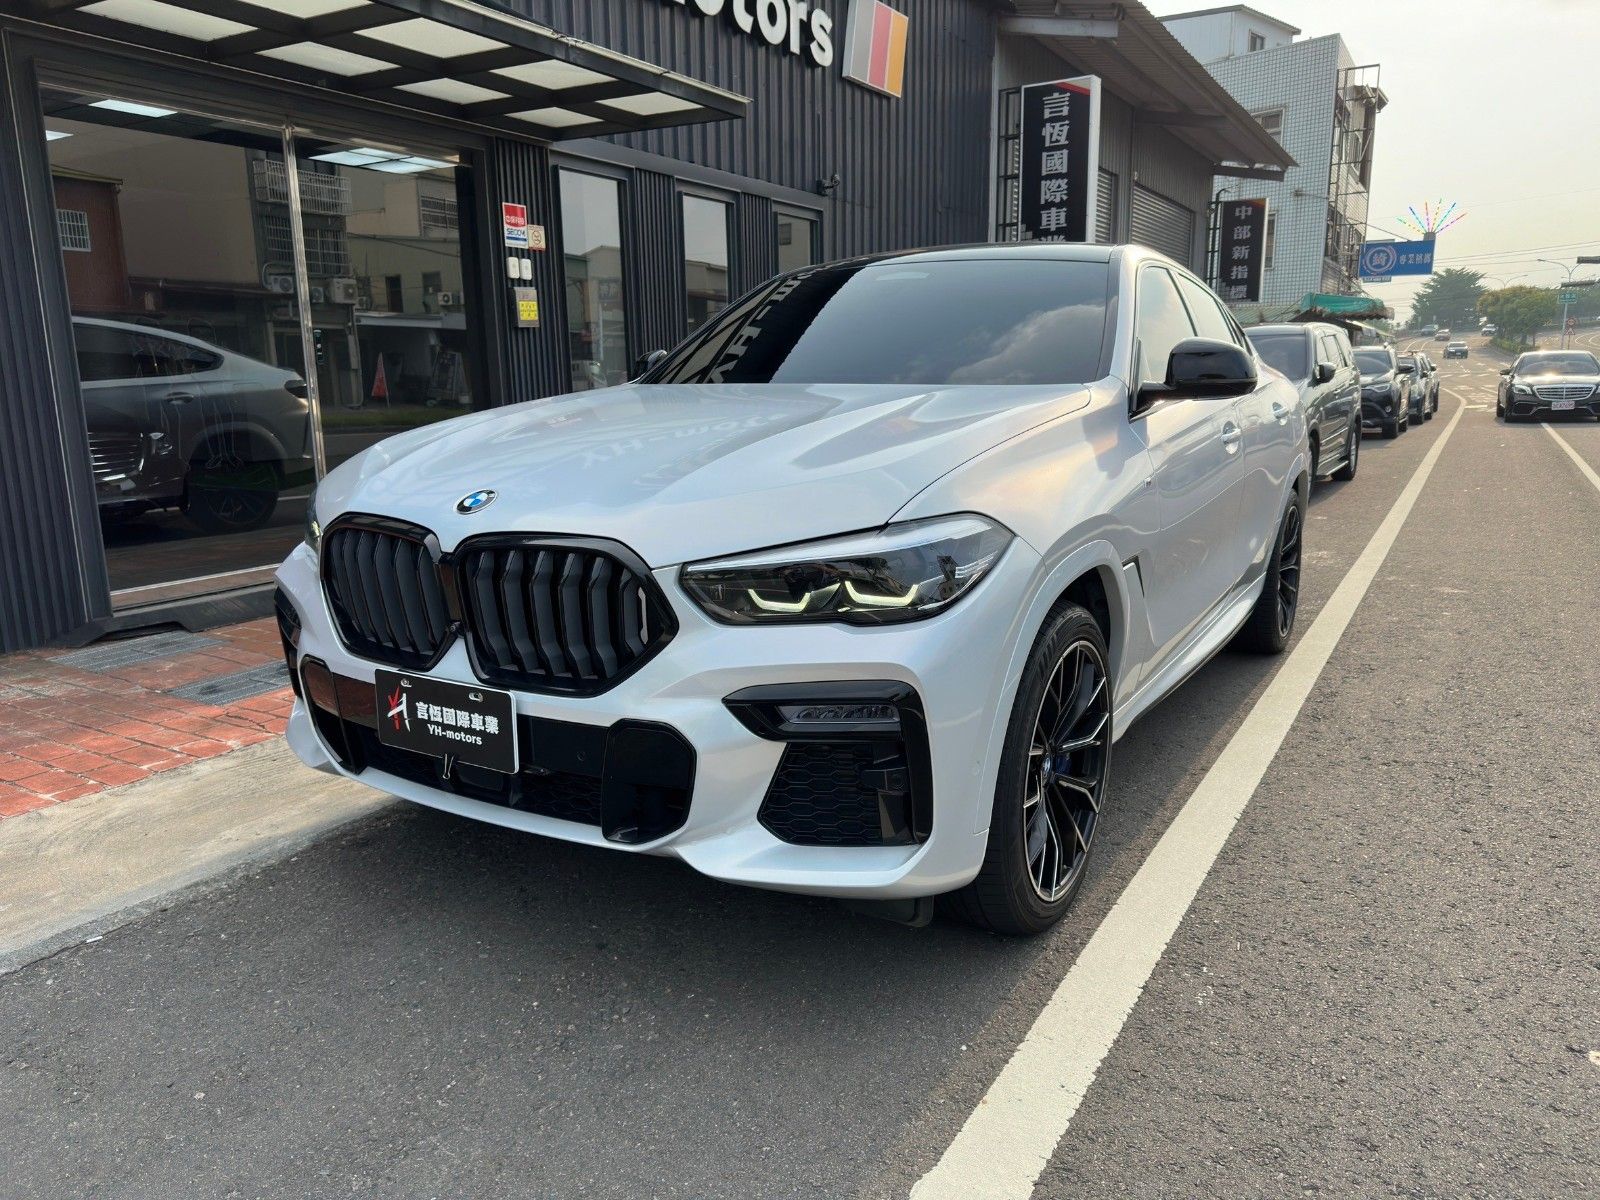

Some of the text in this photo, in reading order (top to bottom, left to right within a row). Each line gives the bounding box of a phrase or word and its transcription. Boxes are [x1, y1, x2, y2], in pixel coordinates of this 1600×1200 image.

[1230, 205, 1253, 299] 中部新指標
[415, 701, 500, 735] 言恆國際車業
[427, 723, 483, 746] YH-motors
